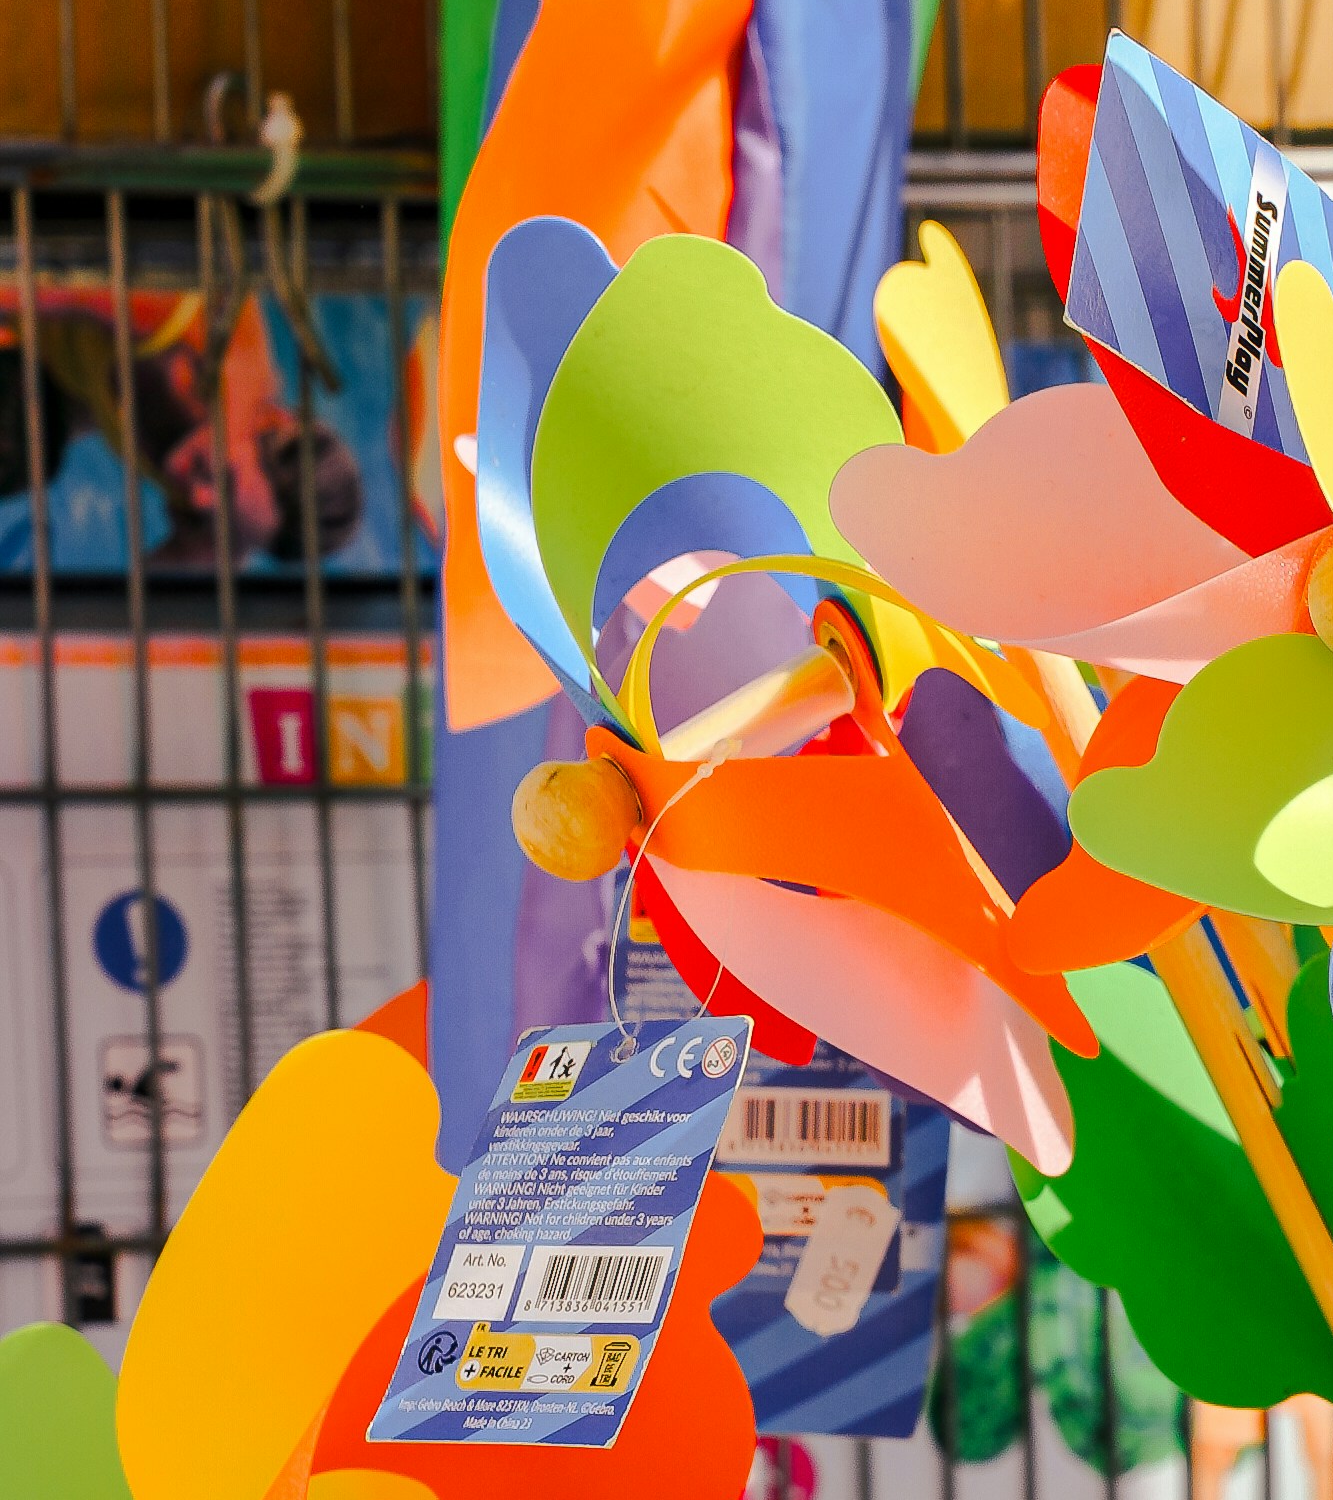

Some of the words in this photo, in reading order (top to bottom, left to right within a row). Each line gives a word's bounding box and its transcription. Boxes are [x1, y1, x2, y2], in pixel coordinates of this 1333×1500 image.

[1226, 191, 1277, 397] SummerPlay
[463, 1253, 484, 1267] Art.
[489, 1253, 507, 1267] No.
[448, 1283, 504, 1299] 623231
[540, 1300, 589, 1311] 713836
[595, 1301, 644, 1312] 041551
[468, 1346, 485, 1358] LE
[487, 1347, 508, 1358] TRI
[555, 1351, 590, 1362] CARTON
[480, 1366, 524, 1378] FACILE
[550, 1374, 575, 1384] CORD
